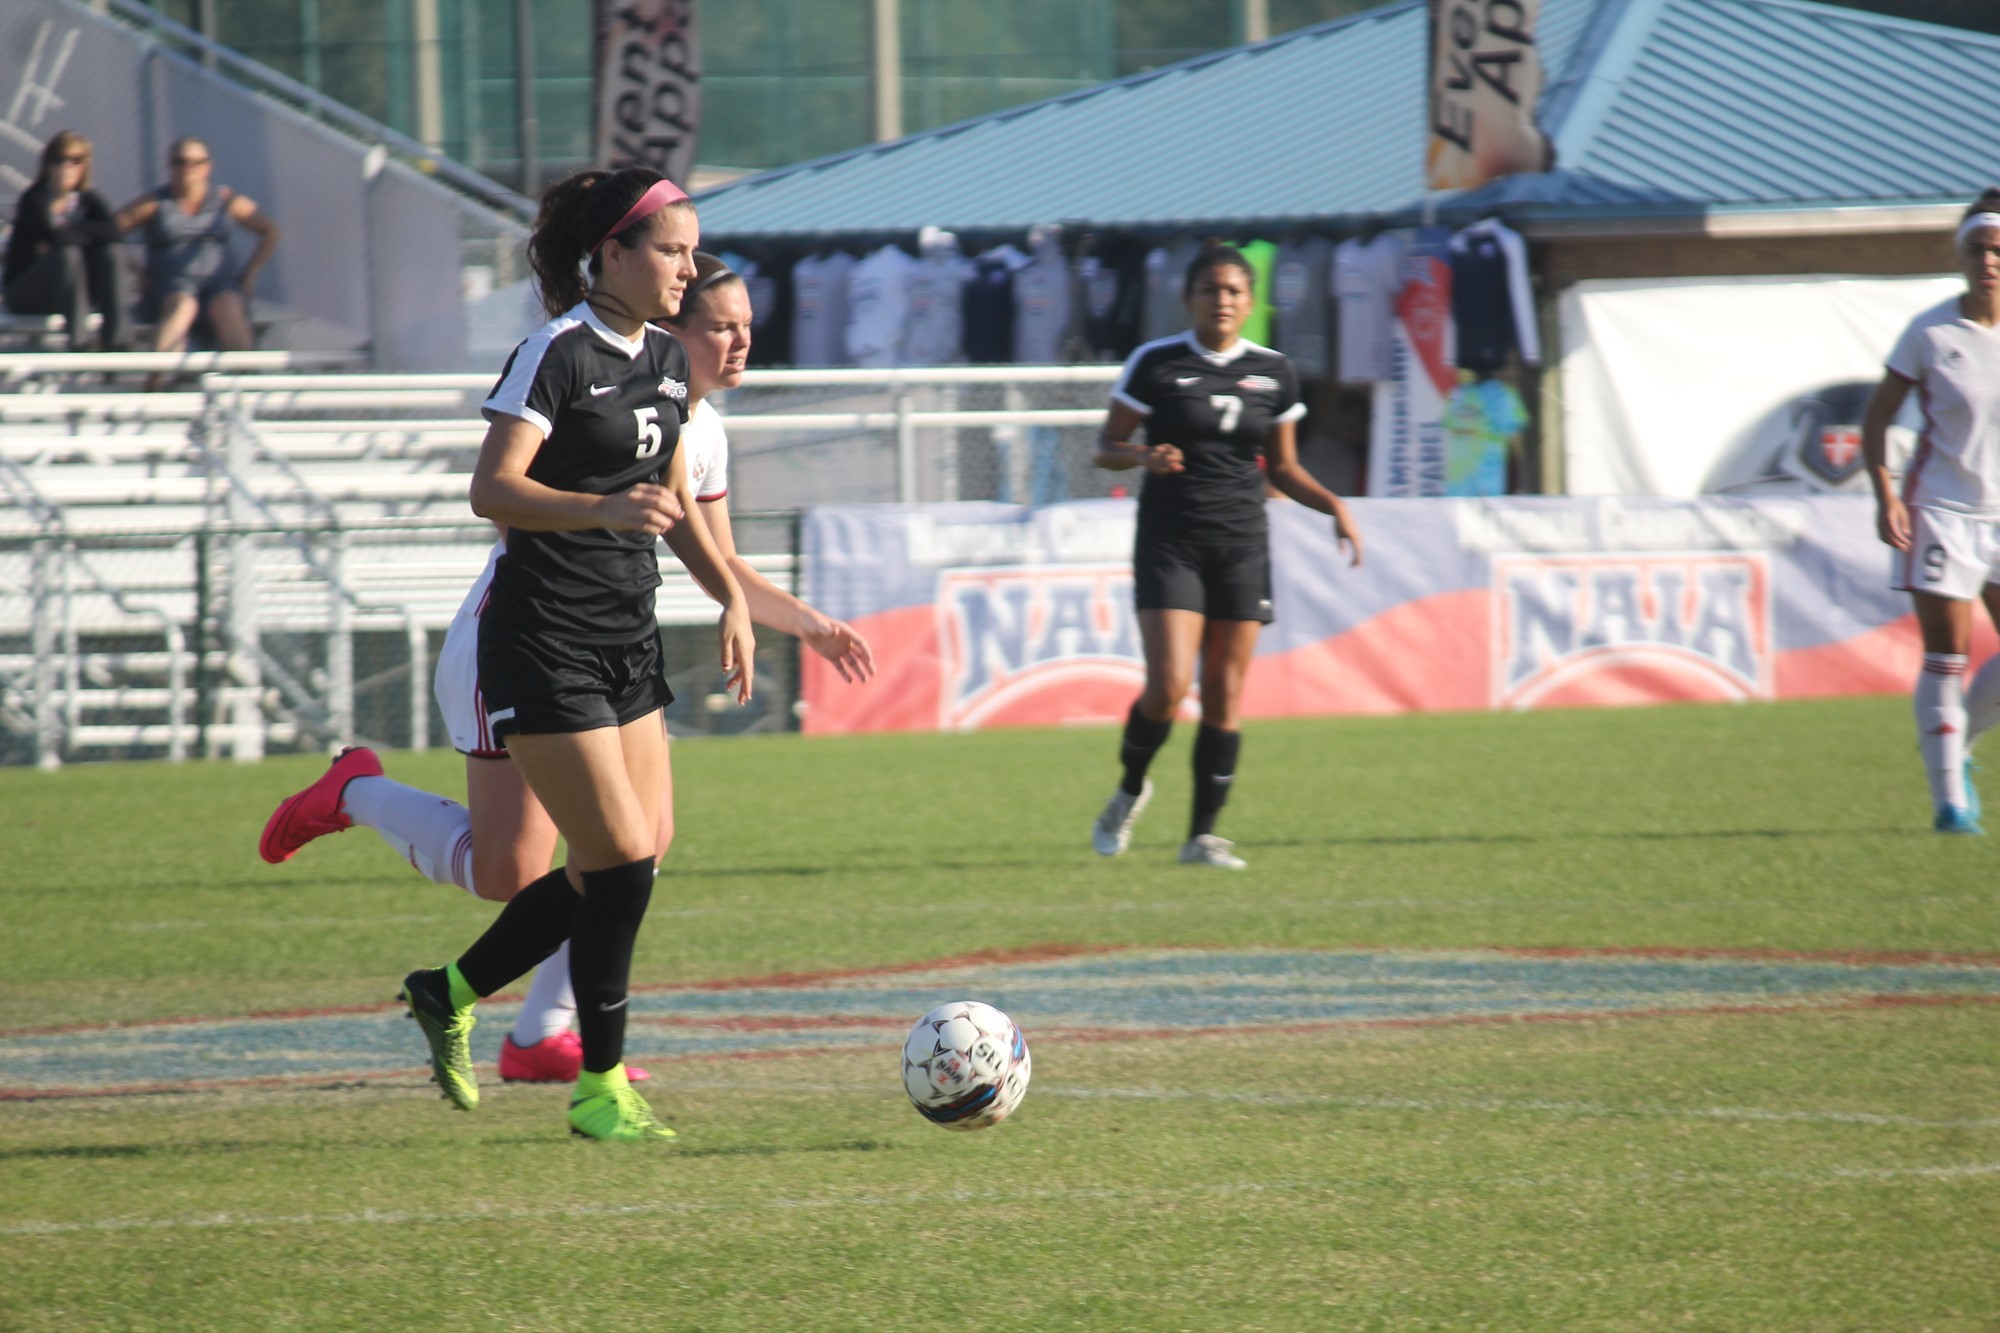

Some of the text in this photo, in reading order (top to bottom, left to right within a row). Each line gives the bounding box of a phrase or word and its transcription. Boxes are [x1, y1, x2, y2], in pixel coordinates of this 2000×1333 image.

[633, 407, 662, 460] 5
[1209, 395, 1243, 433] 7
[1924, 543, 1948, 583] 9
[954, 583, 1137, 701] NAI
[1509, 569, 1758, 684] NAIA
